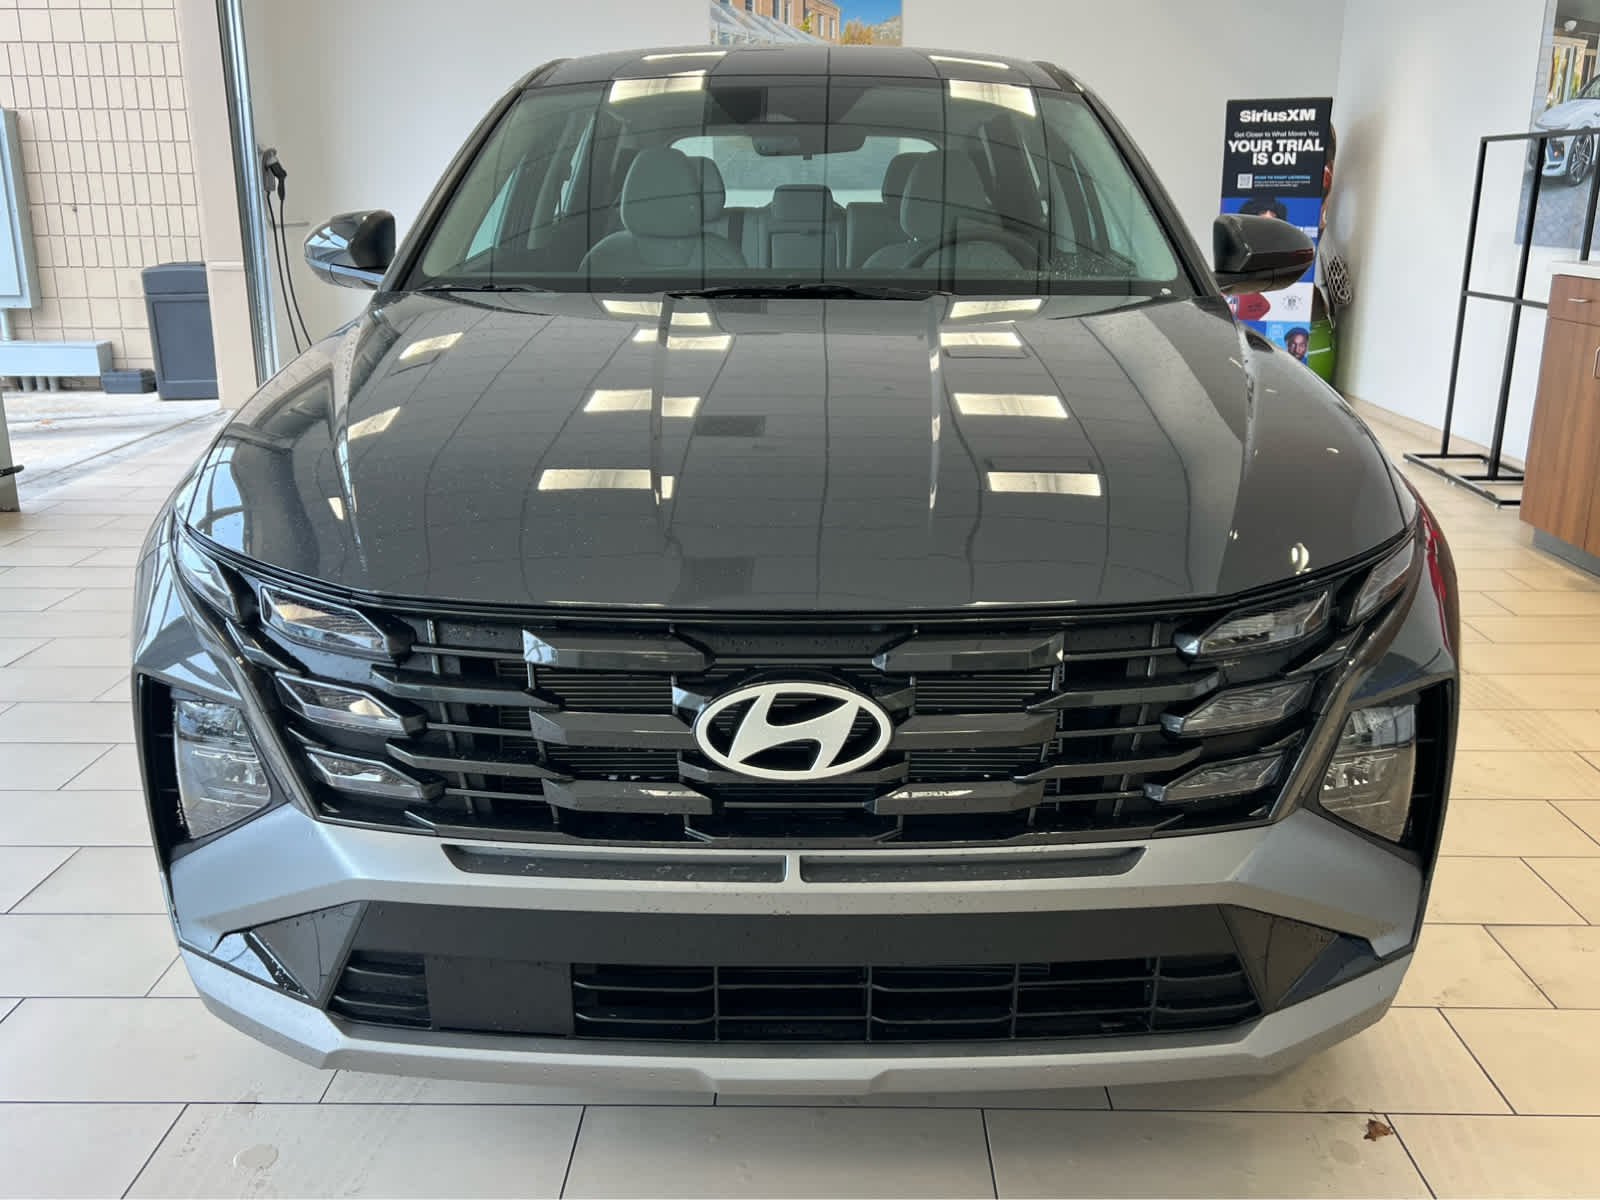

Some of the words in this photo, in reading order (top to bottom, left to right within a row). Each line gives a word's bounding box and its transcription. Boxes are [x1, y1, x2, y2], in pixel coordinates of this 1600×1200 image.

[1240, 108, 1316, 122] SiriusXM
[1308, 129, 1319, 137] You
[1228, 140, 1273, 153] YOUR
[1276, 139, 1324, 152] TRIAL
[1252, 152, 1268, 166] IS
[1271, 152, 1297, 165] ON
